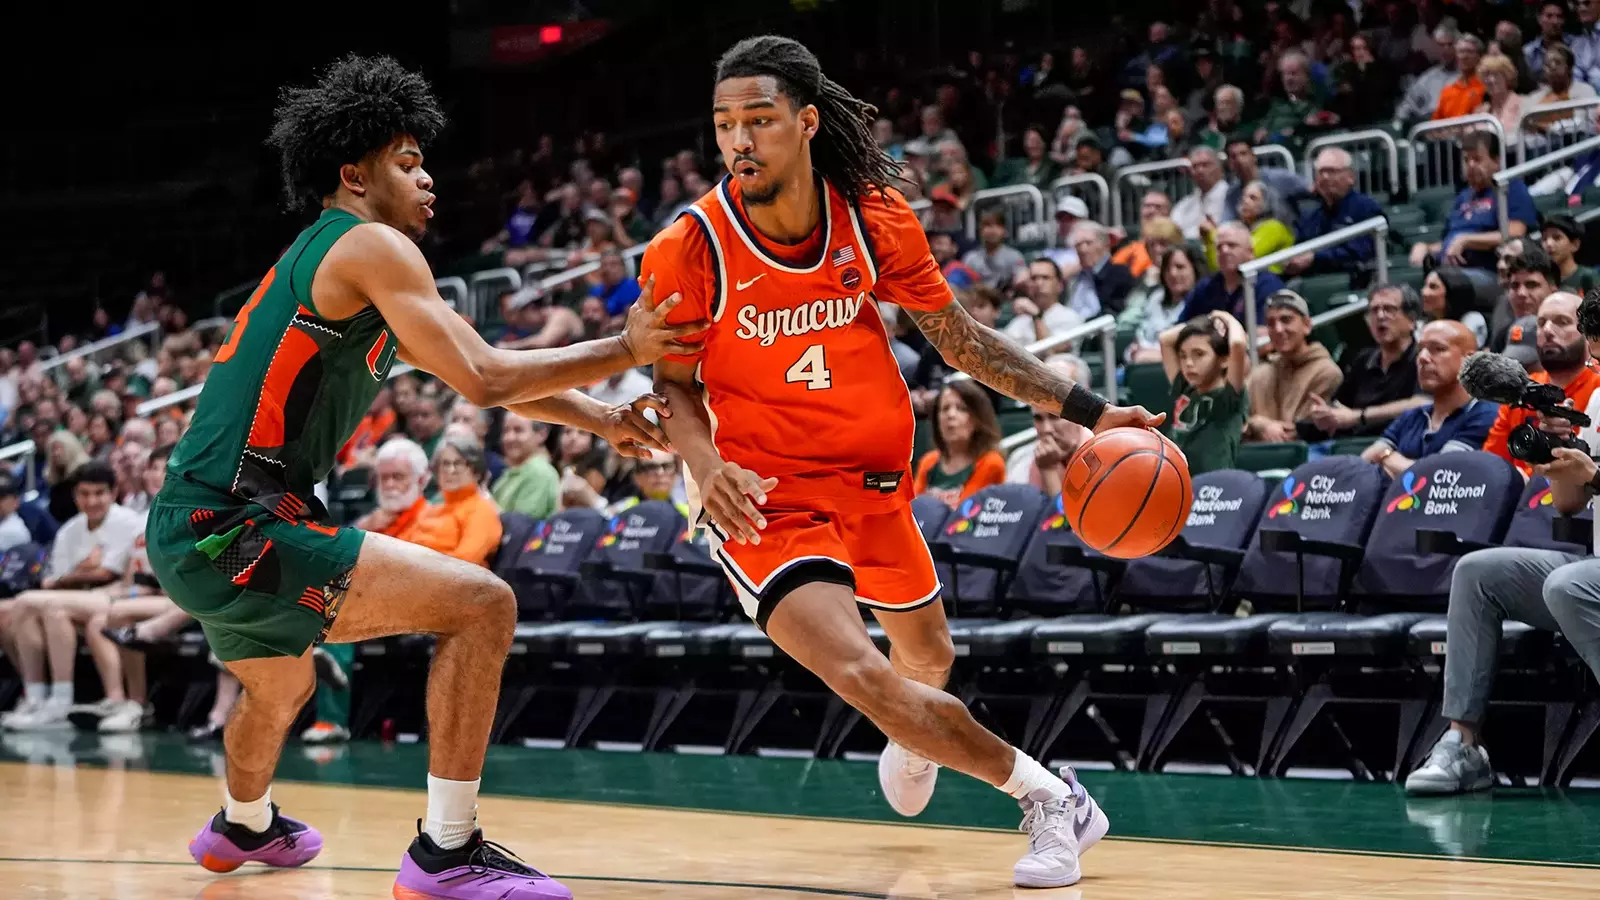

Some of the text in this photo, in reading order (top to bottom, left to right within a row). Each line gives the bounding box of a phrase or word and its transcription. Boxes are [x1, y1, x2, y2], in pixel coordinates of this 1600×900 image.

[785, 343, 832, 391] 4
[1310, 474, 1336, 491] City
[1433, 468, 1462, 486] City
[1199, 485, 1224, 500] City
[1305, 489, 1357, 504] National
[1428, 484, 1486, 500] National
[1191, 498, 1243, 513] National
[1301, 506, 1332, 520] Bank
[1423, 500, 1459, 515] Bank
[1186, 512, 1217, 527] Bank
